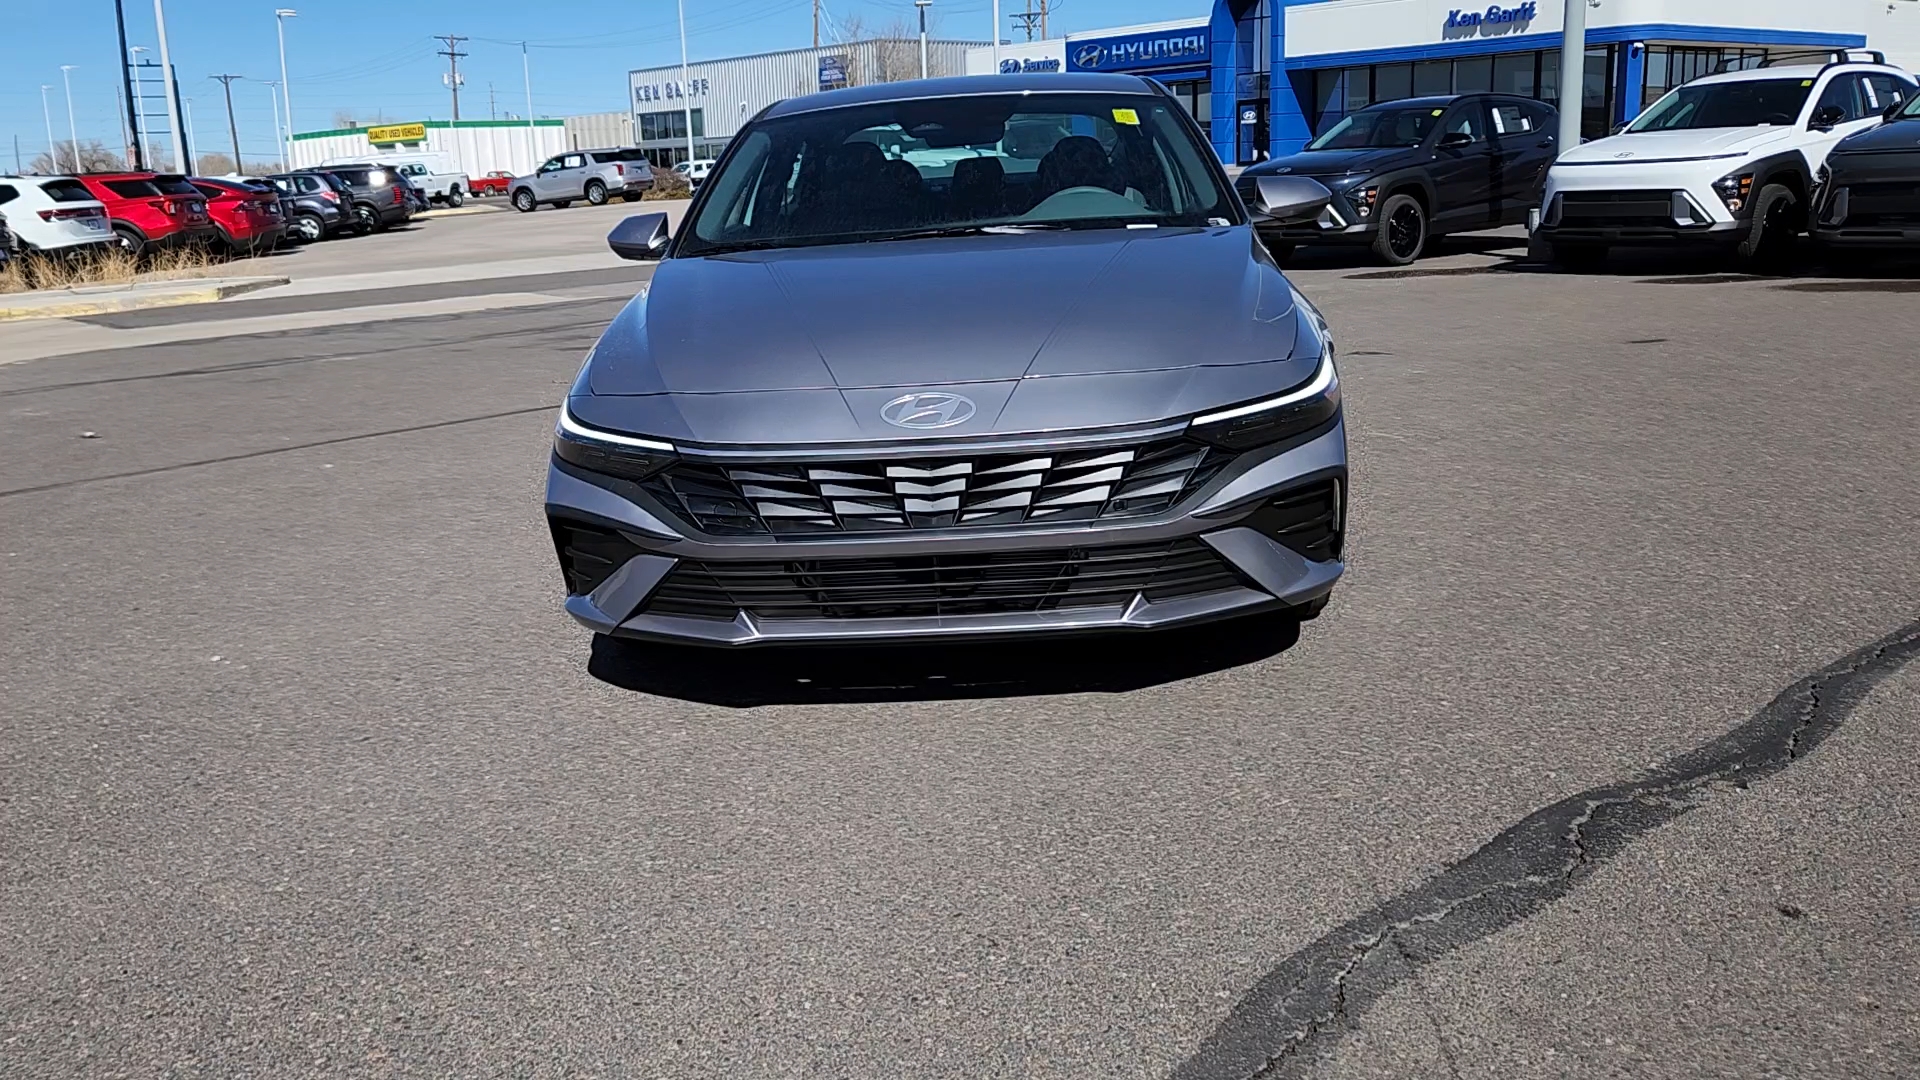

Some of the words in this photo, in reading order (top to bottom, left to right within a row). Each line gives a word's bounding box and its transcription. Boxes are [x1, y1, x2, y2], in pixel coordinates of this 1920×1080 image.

[1448, 9, 1482, 28] Ken
[1485, 1, 1537, 25] Garff
[1111, 35, 1205, 63] HYUNDAI
[1023, 56, 1061, 71] Service
[635, 84, 660, 100] KEN
[368, 129, 388, 140] QUALITY
[389, 128, 401, 138] USED
[401, 126, 424, 137] VEHICLES
